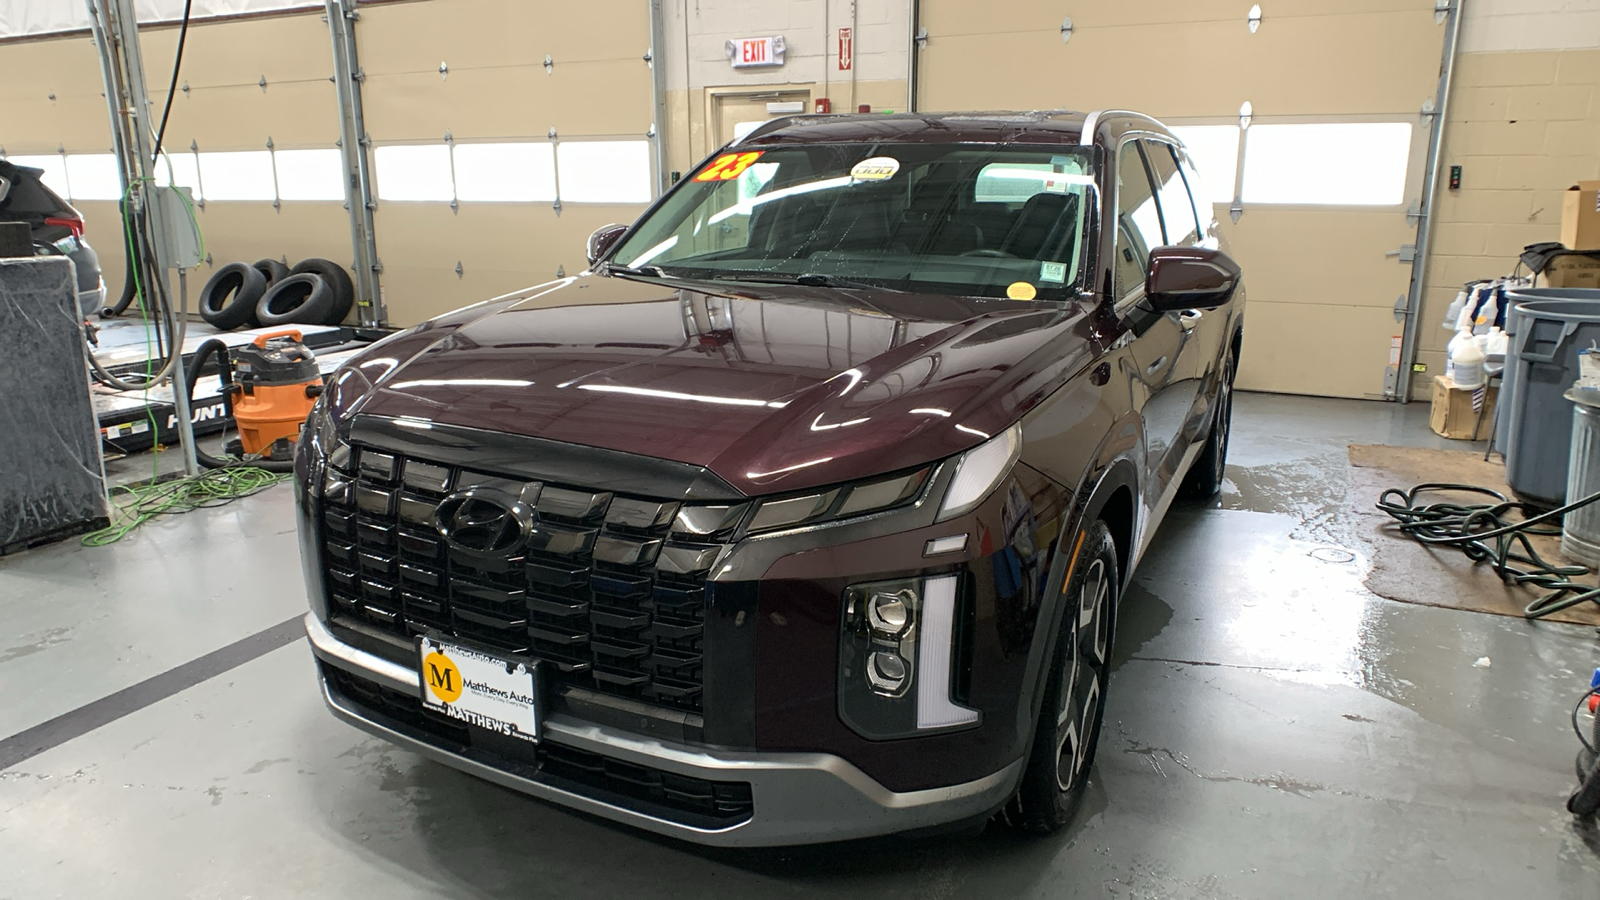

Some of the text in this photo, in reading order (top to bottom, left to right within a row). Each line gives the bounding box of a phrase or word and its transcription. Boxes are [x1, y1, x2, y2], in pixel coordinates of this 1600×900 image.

[743, 39, 766, 63] EXIT
[697, 152, 759, 181] 23
[439, 643, 508, 669] MatthewsAuto.com
[428, 662, 455, 693] M
[463, 677, 535, 705] Matthews Auto
[447, 706, 511, 736] MATTHEWS
